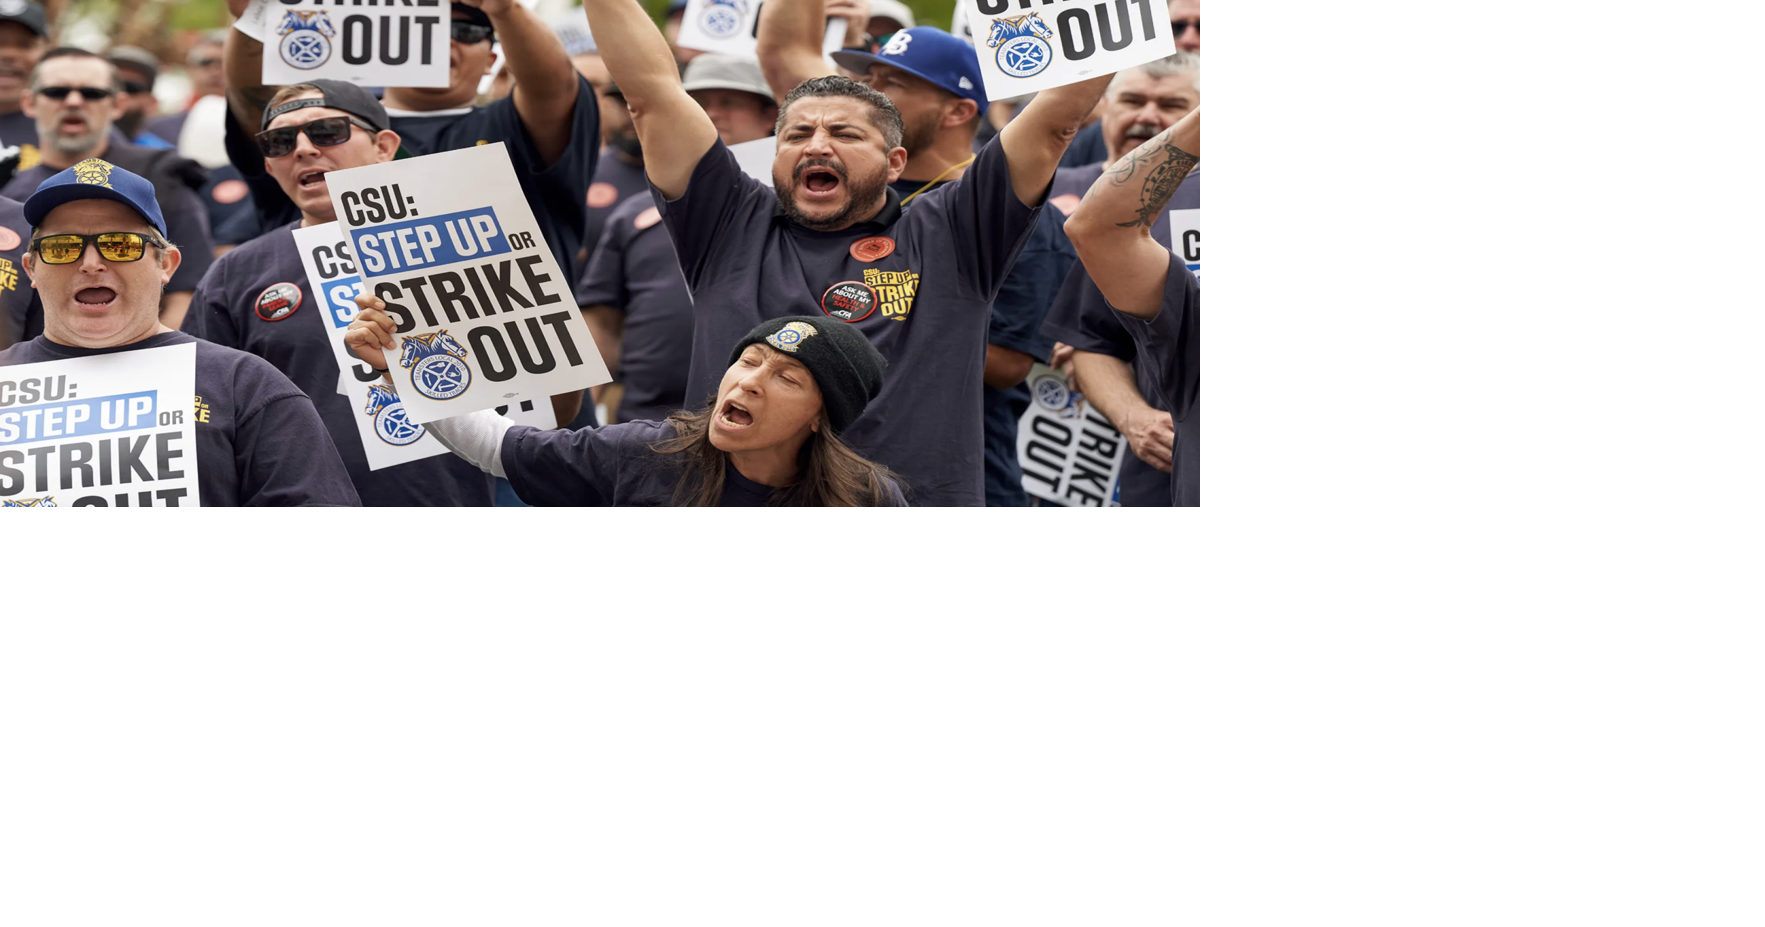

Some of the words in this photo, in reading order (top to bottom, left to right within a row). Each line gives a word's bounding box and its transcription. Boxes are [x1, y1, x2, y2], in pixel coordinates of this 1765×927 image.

[342, 14, 440, 66] OUT
[1057, 0, 1156, 61] OUT
[341, 184, 418, 226] CSU:
[312, 241, 358, 279] CS
[358, 224, 441, 273] STEP
[445, 214, 499, 257] UP
[508, 231, 536, 250] OR
[374, 254, 562, 334] STRIKE
[833, 288, 859, 300] ABOUT
[858, 296, 871, 304] MY
[841, 285, 857, 294] ASK
[856, 290, 869, 298] ME
[865, 272, 894, 286] STEP
[895, 271, 910, 284] UP
[870, 280, 920, 303] TRIK
[832, 294, 860, 306] HEALTH
[833, 300, 860, 312] SAFETY
[838, 309, 852, 320] CFA
[880, 296, 914, 317] OUT
[467, 310, 584, 382] OUT
[415, 356, 434, 381] TEAMSTERS
[435, 355, 453, 363] LOCAL
[0, 375, 77, 407] CSU:
[425, 388, 449, 398] SKILLED
[449, 382, 467, 397] TRADES
[0, 403, 91, 443] STEP
[100, 396, 153, 430] UP
[158, 409, 184, 427] OR
[0, 431, 185, 497] STRIKE
[1020, 415, 1072, 494] OUT
[1065, 414, 1121, 507] TRIKE
